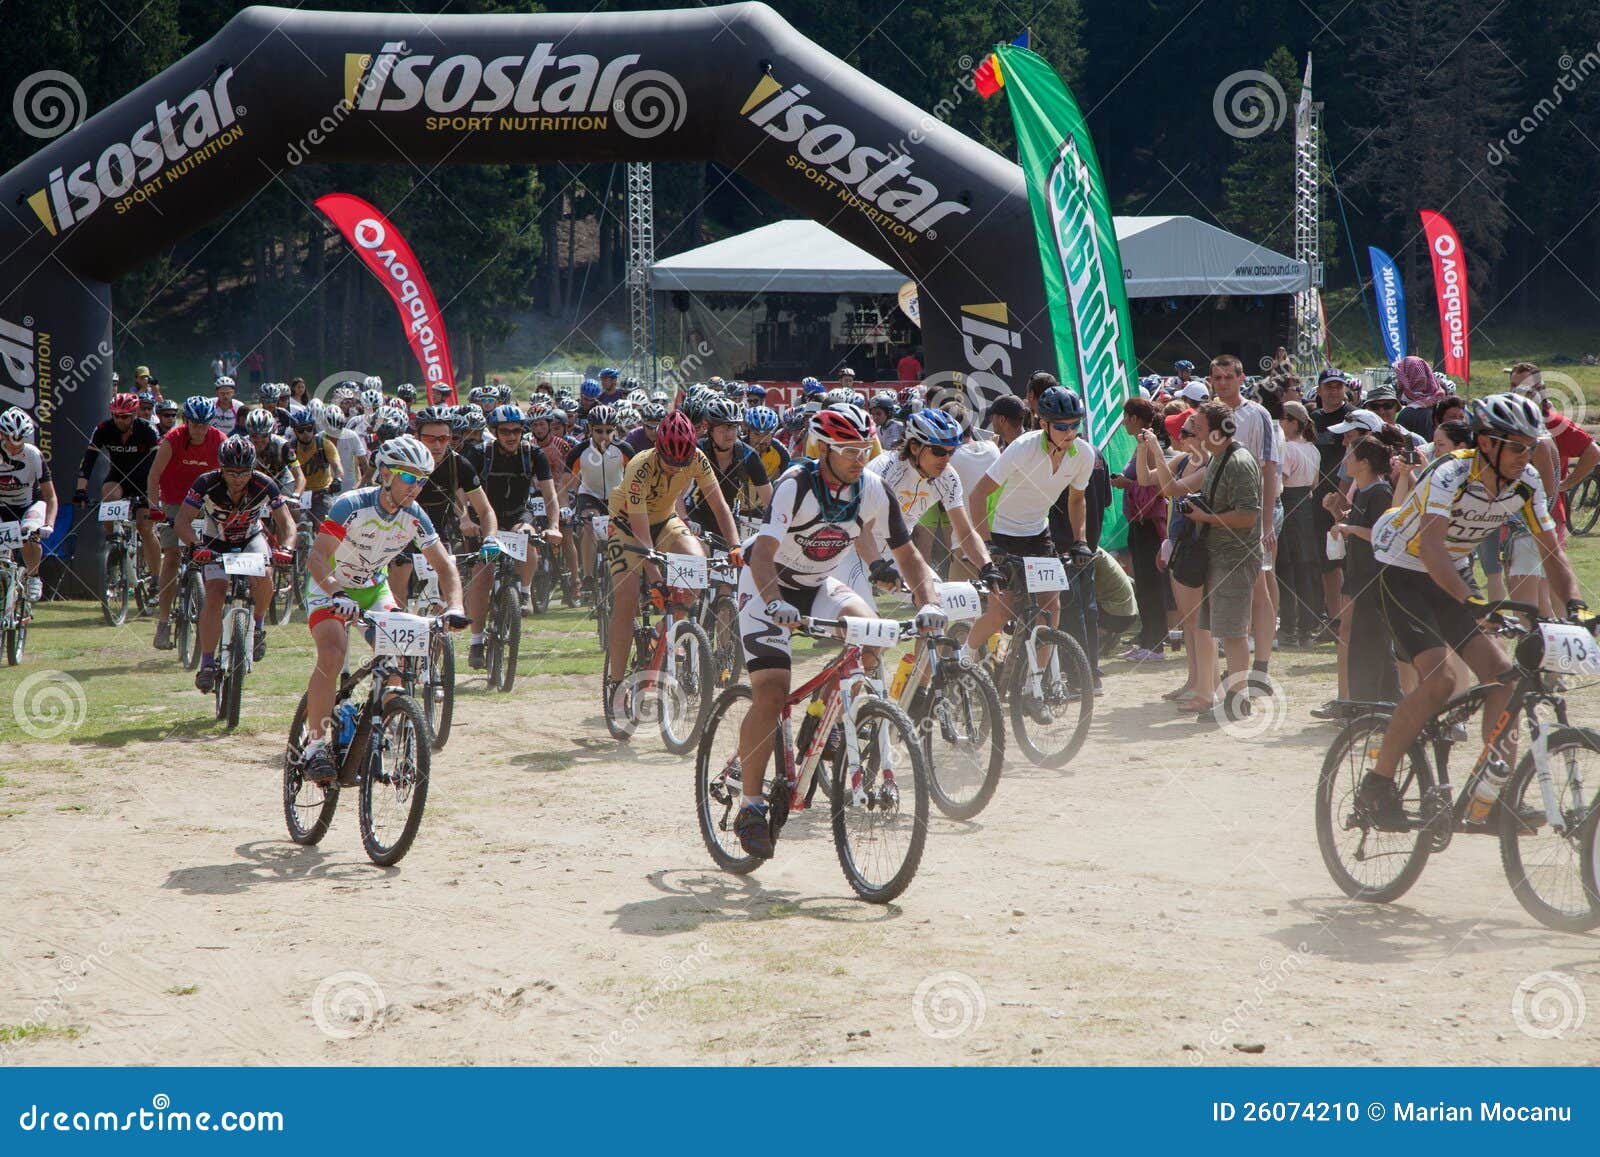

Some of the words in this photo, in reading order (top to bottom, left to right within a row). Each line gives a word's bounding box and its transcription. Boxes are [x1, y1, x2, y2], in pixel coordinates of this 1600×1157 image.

[357, 42, 641, 113] isostar
[425, 116, 492, 131] SPORT
[500, 116, 608, 131] NUTRITION
[49, 67, 235, 232] isostar
[748, 83, 971, 235] isostar
[114, 178, 164, 215] SPORT
[168, 125, 245, 184] NUTRITION
[786, 154, 837, 193] SPORT
[836, 188, 918, 245] NUTRITION
[107, 505, 120, 516] 50
[1037, 569, 1055, 581] 177
[946, 594, 966, 608] 110
[391, 629, 415, 644] 125
[1561, 637, 1588, 661] 13
